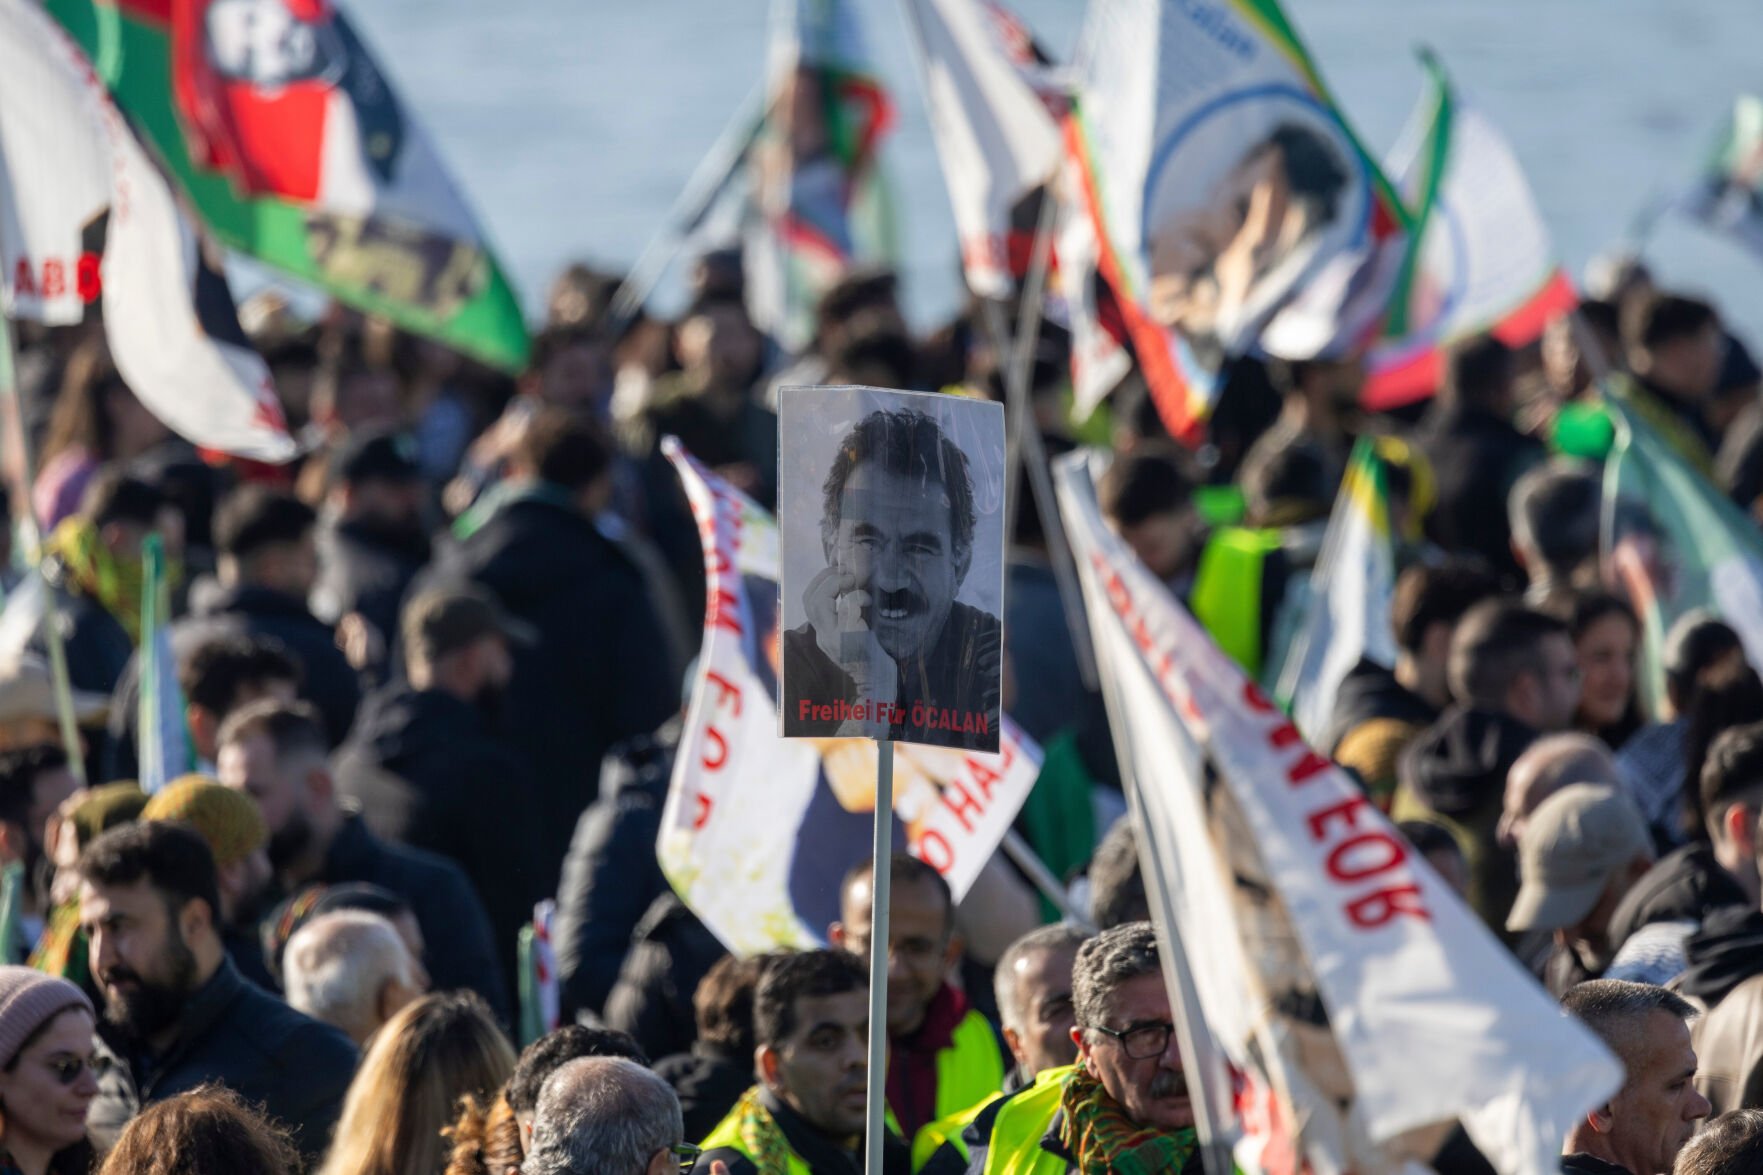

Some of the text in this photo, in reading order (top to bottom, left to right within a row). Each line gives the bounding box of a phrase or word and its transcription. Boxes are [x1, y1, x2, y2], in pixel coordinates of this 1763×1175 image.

[799, 698, 989, 735] Freihei Für ÖCALAN
